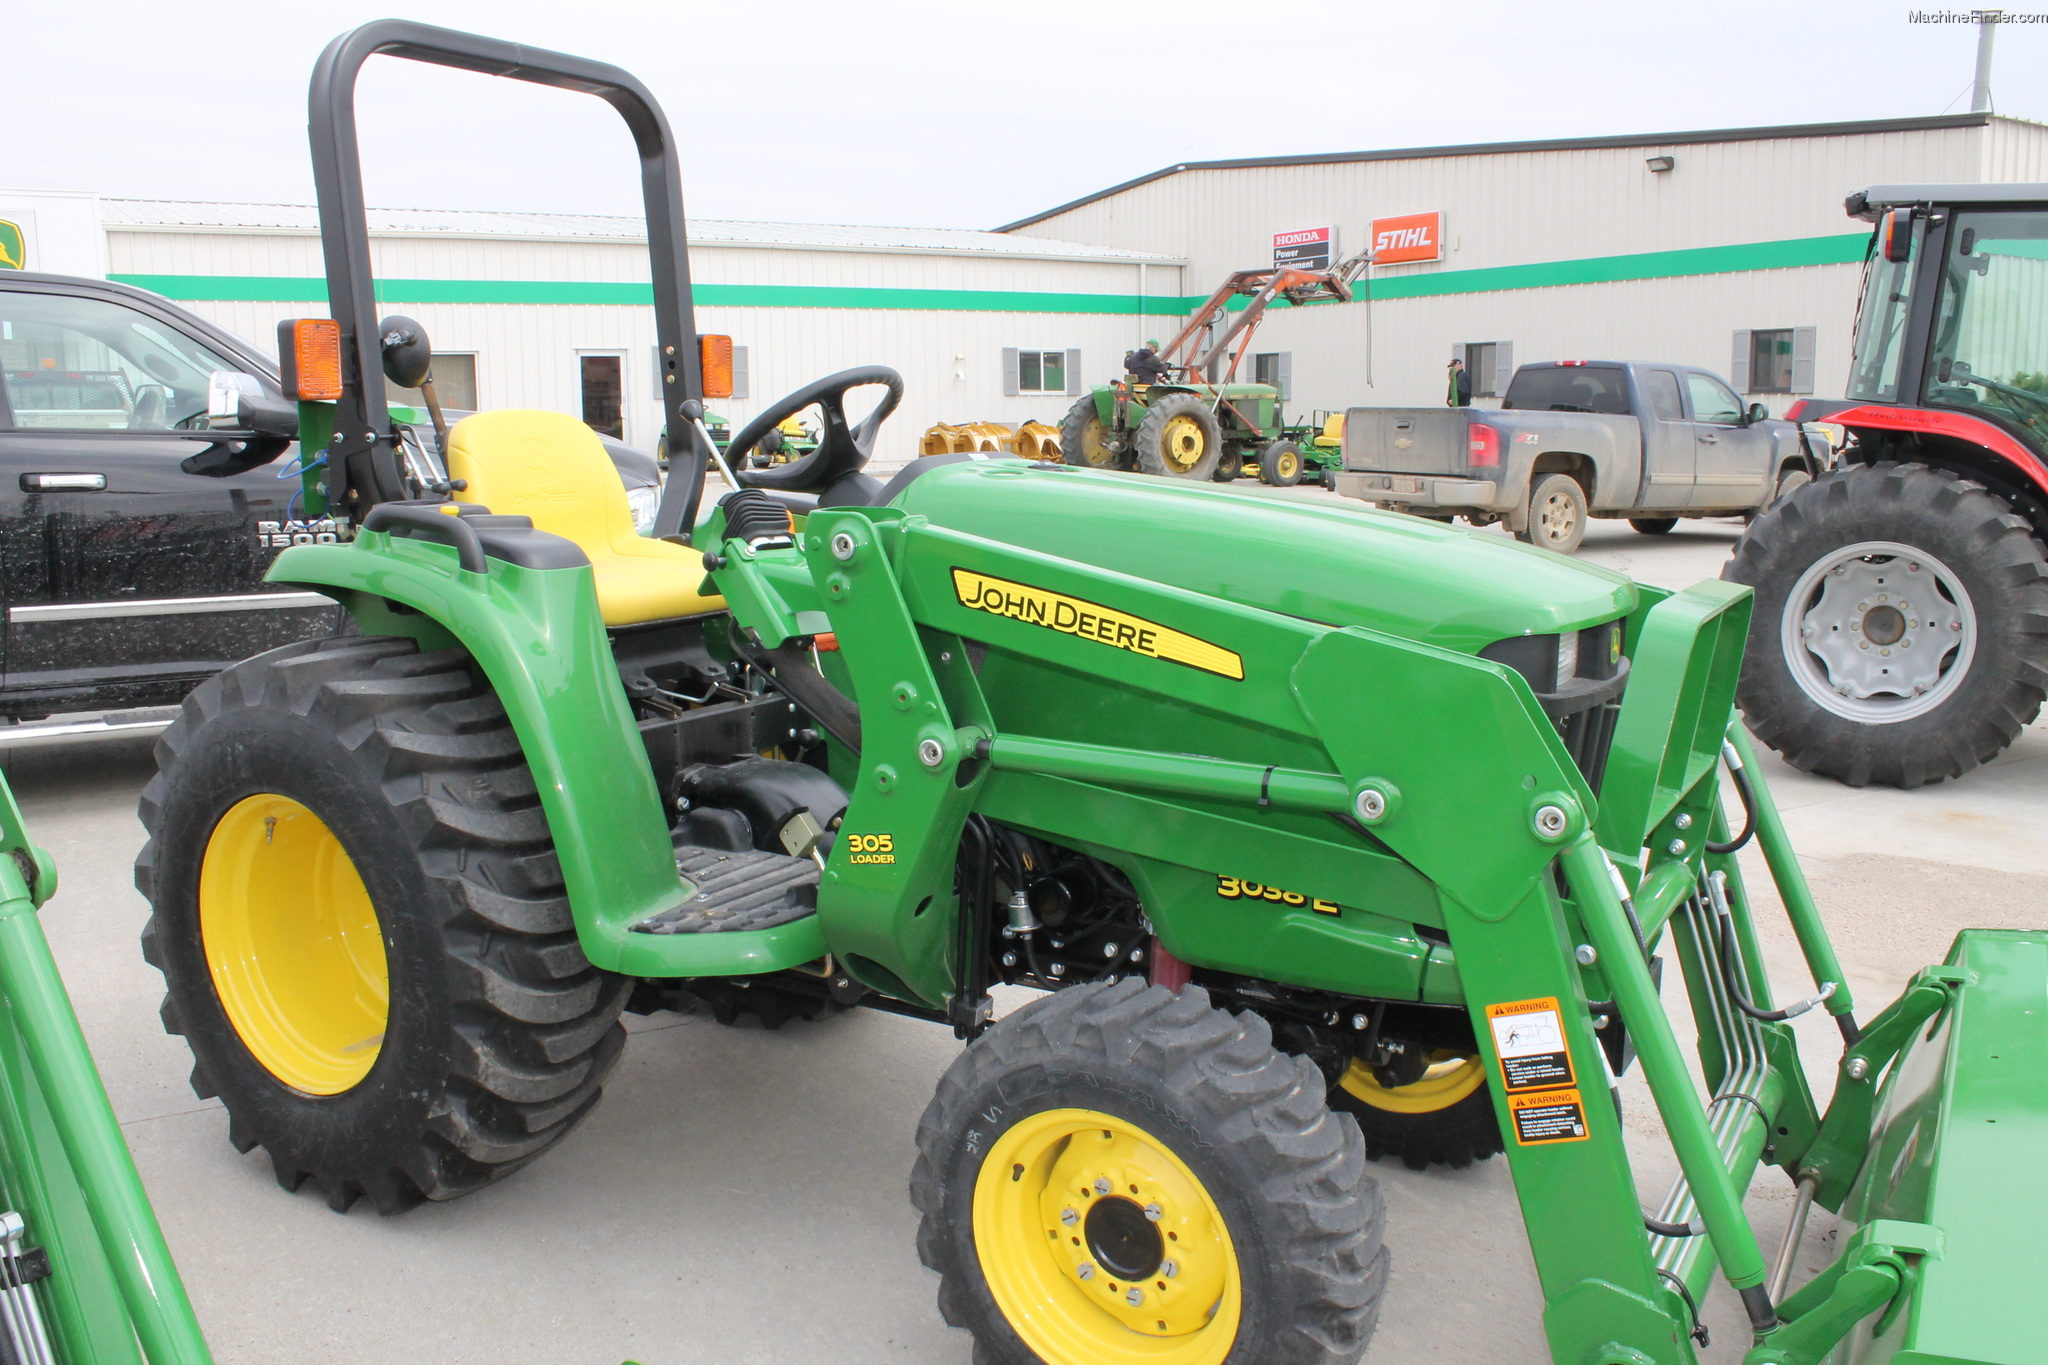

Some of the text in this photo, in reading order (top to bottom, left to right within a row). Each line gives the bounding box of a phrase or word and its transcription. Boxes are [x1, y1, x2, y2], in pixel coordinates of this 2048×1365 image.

[1276, 231, 1320, 246] HONDA
[1376, 227, 1432, 251] STIHL
[1276, 250, 1299, 259] Power
[258, 519, 336, 534] RAM
[258, 532, 337, 547] 1500
[965, 580, 1157, 653] JOHN DEERE
[848, 833, 894, 853] 305
[850, 854, 896, 865] LOADER
[1505, 1001, 1549, 1014] WARNING
[1528, 1094, 1572, 1105] WARNING
